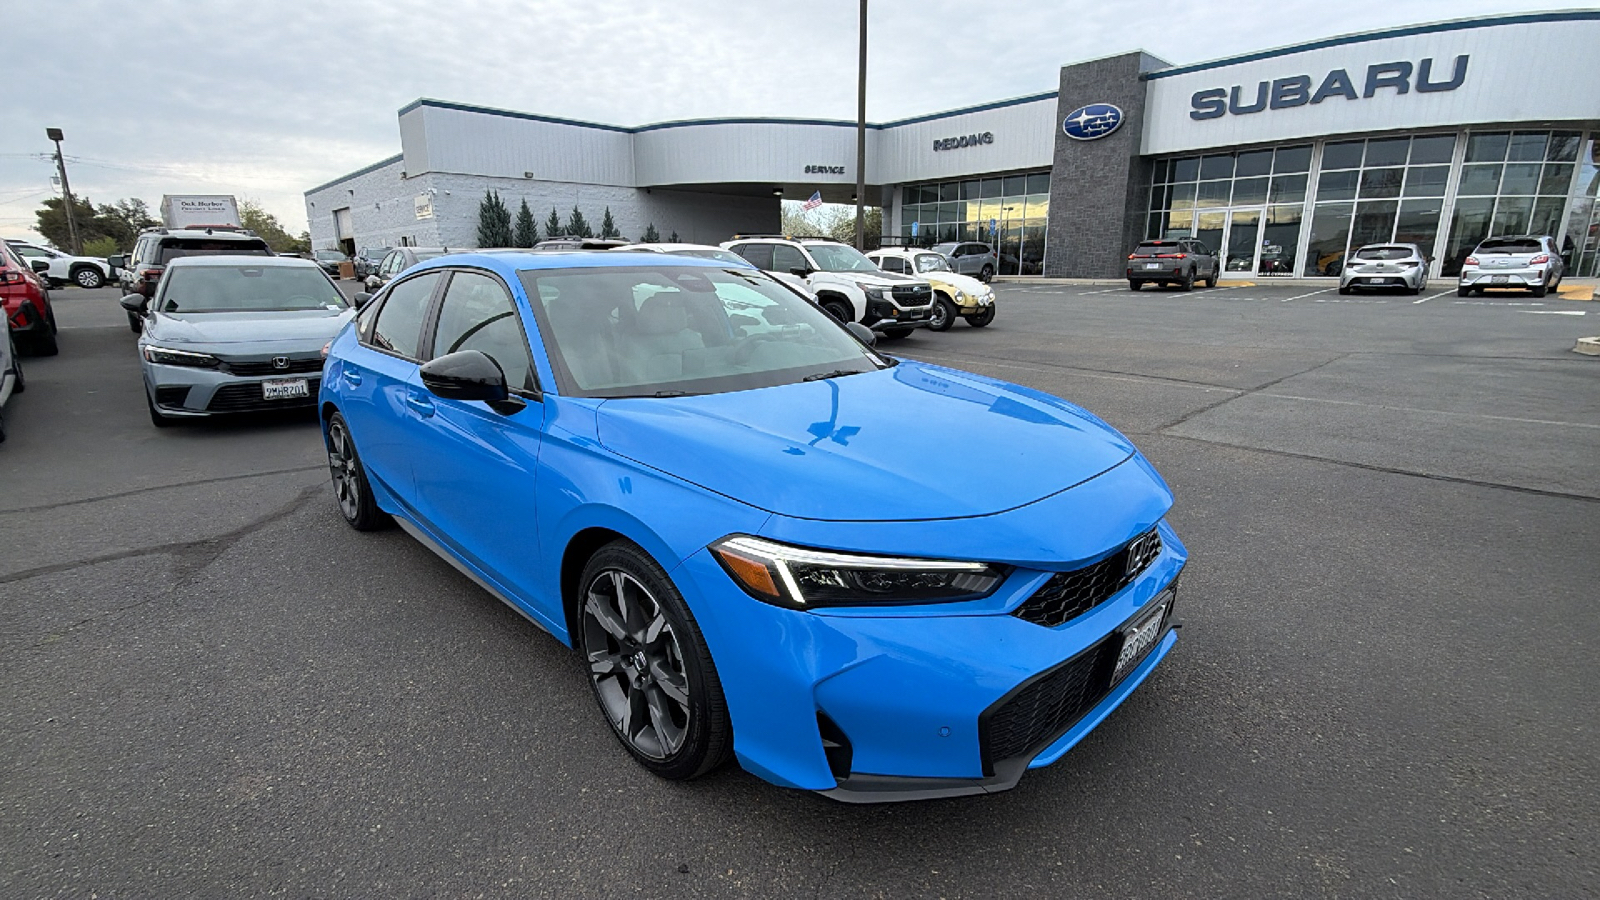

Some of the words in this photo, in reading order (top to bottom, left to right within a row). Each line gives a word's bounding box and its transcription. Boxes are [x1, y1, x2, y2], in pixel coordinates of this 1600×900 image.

[1189, 54, 1470, 121] SUBARU
[933, 131, 994, 152] REDDING
[804, 165, 846, 175] SERVICE
